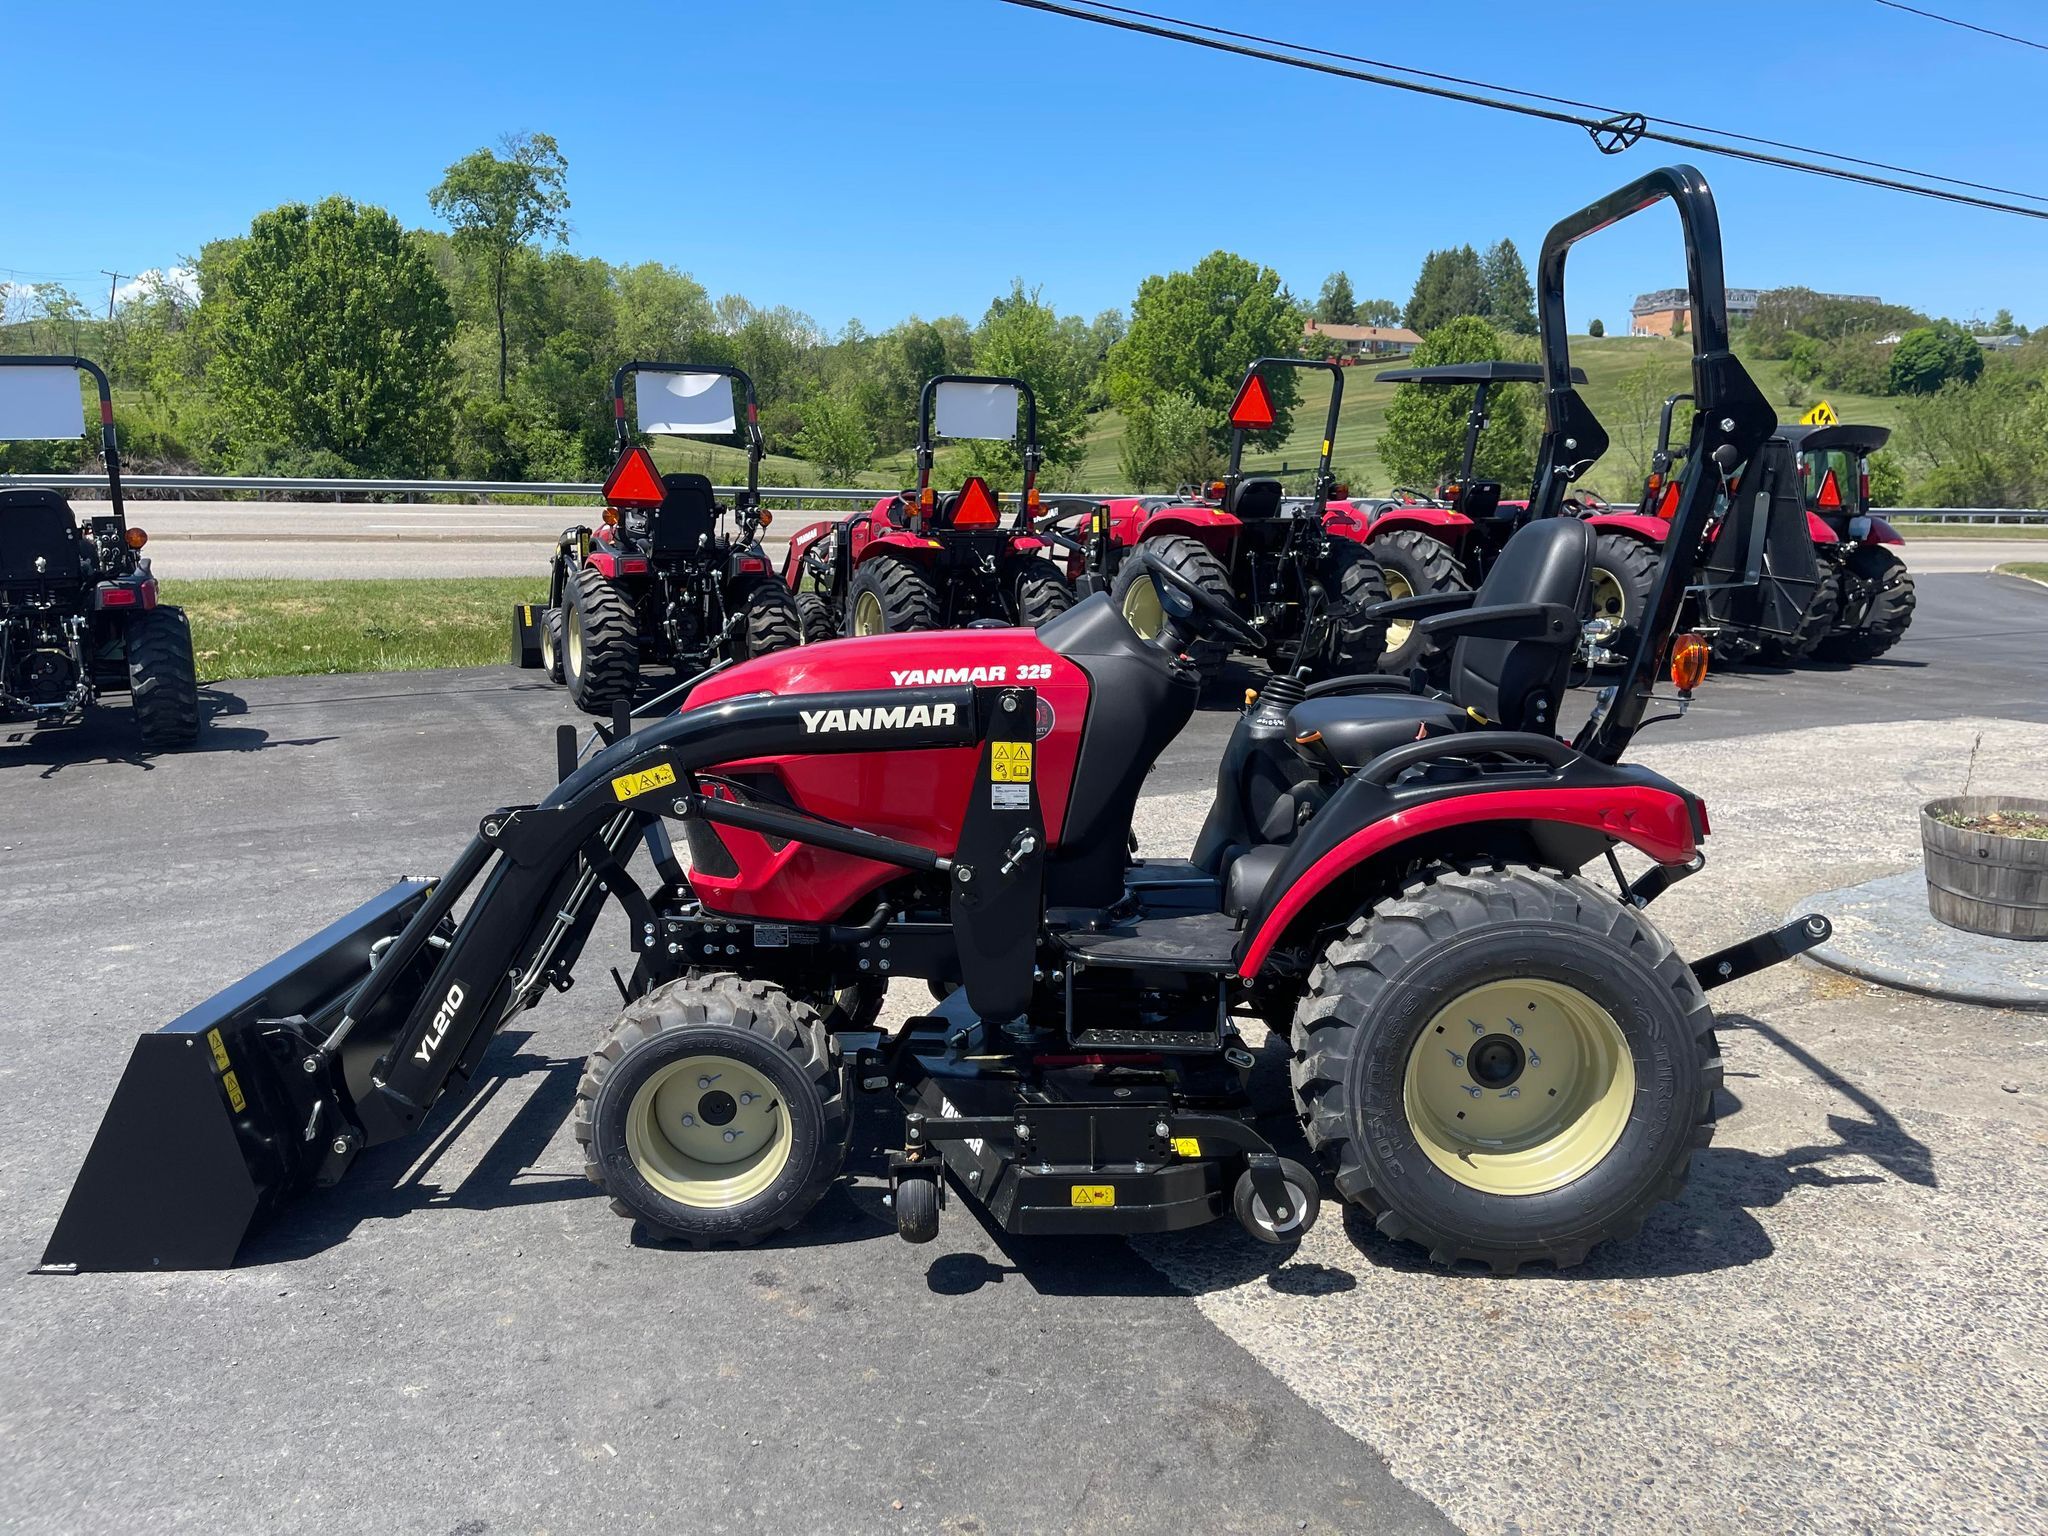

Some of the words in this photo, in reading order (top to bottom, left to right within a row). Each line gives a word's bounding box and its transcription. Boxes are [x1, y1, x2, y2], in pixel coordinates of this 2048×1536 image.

[890, 666, 1006, 686] YANMAR
[1016, 664, 1052, 679] 325
[799, 703, 956, 734] YANMAR
[414, 984, 464, 1063] YL210
